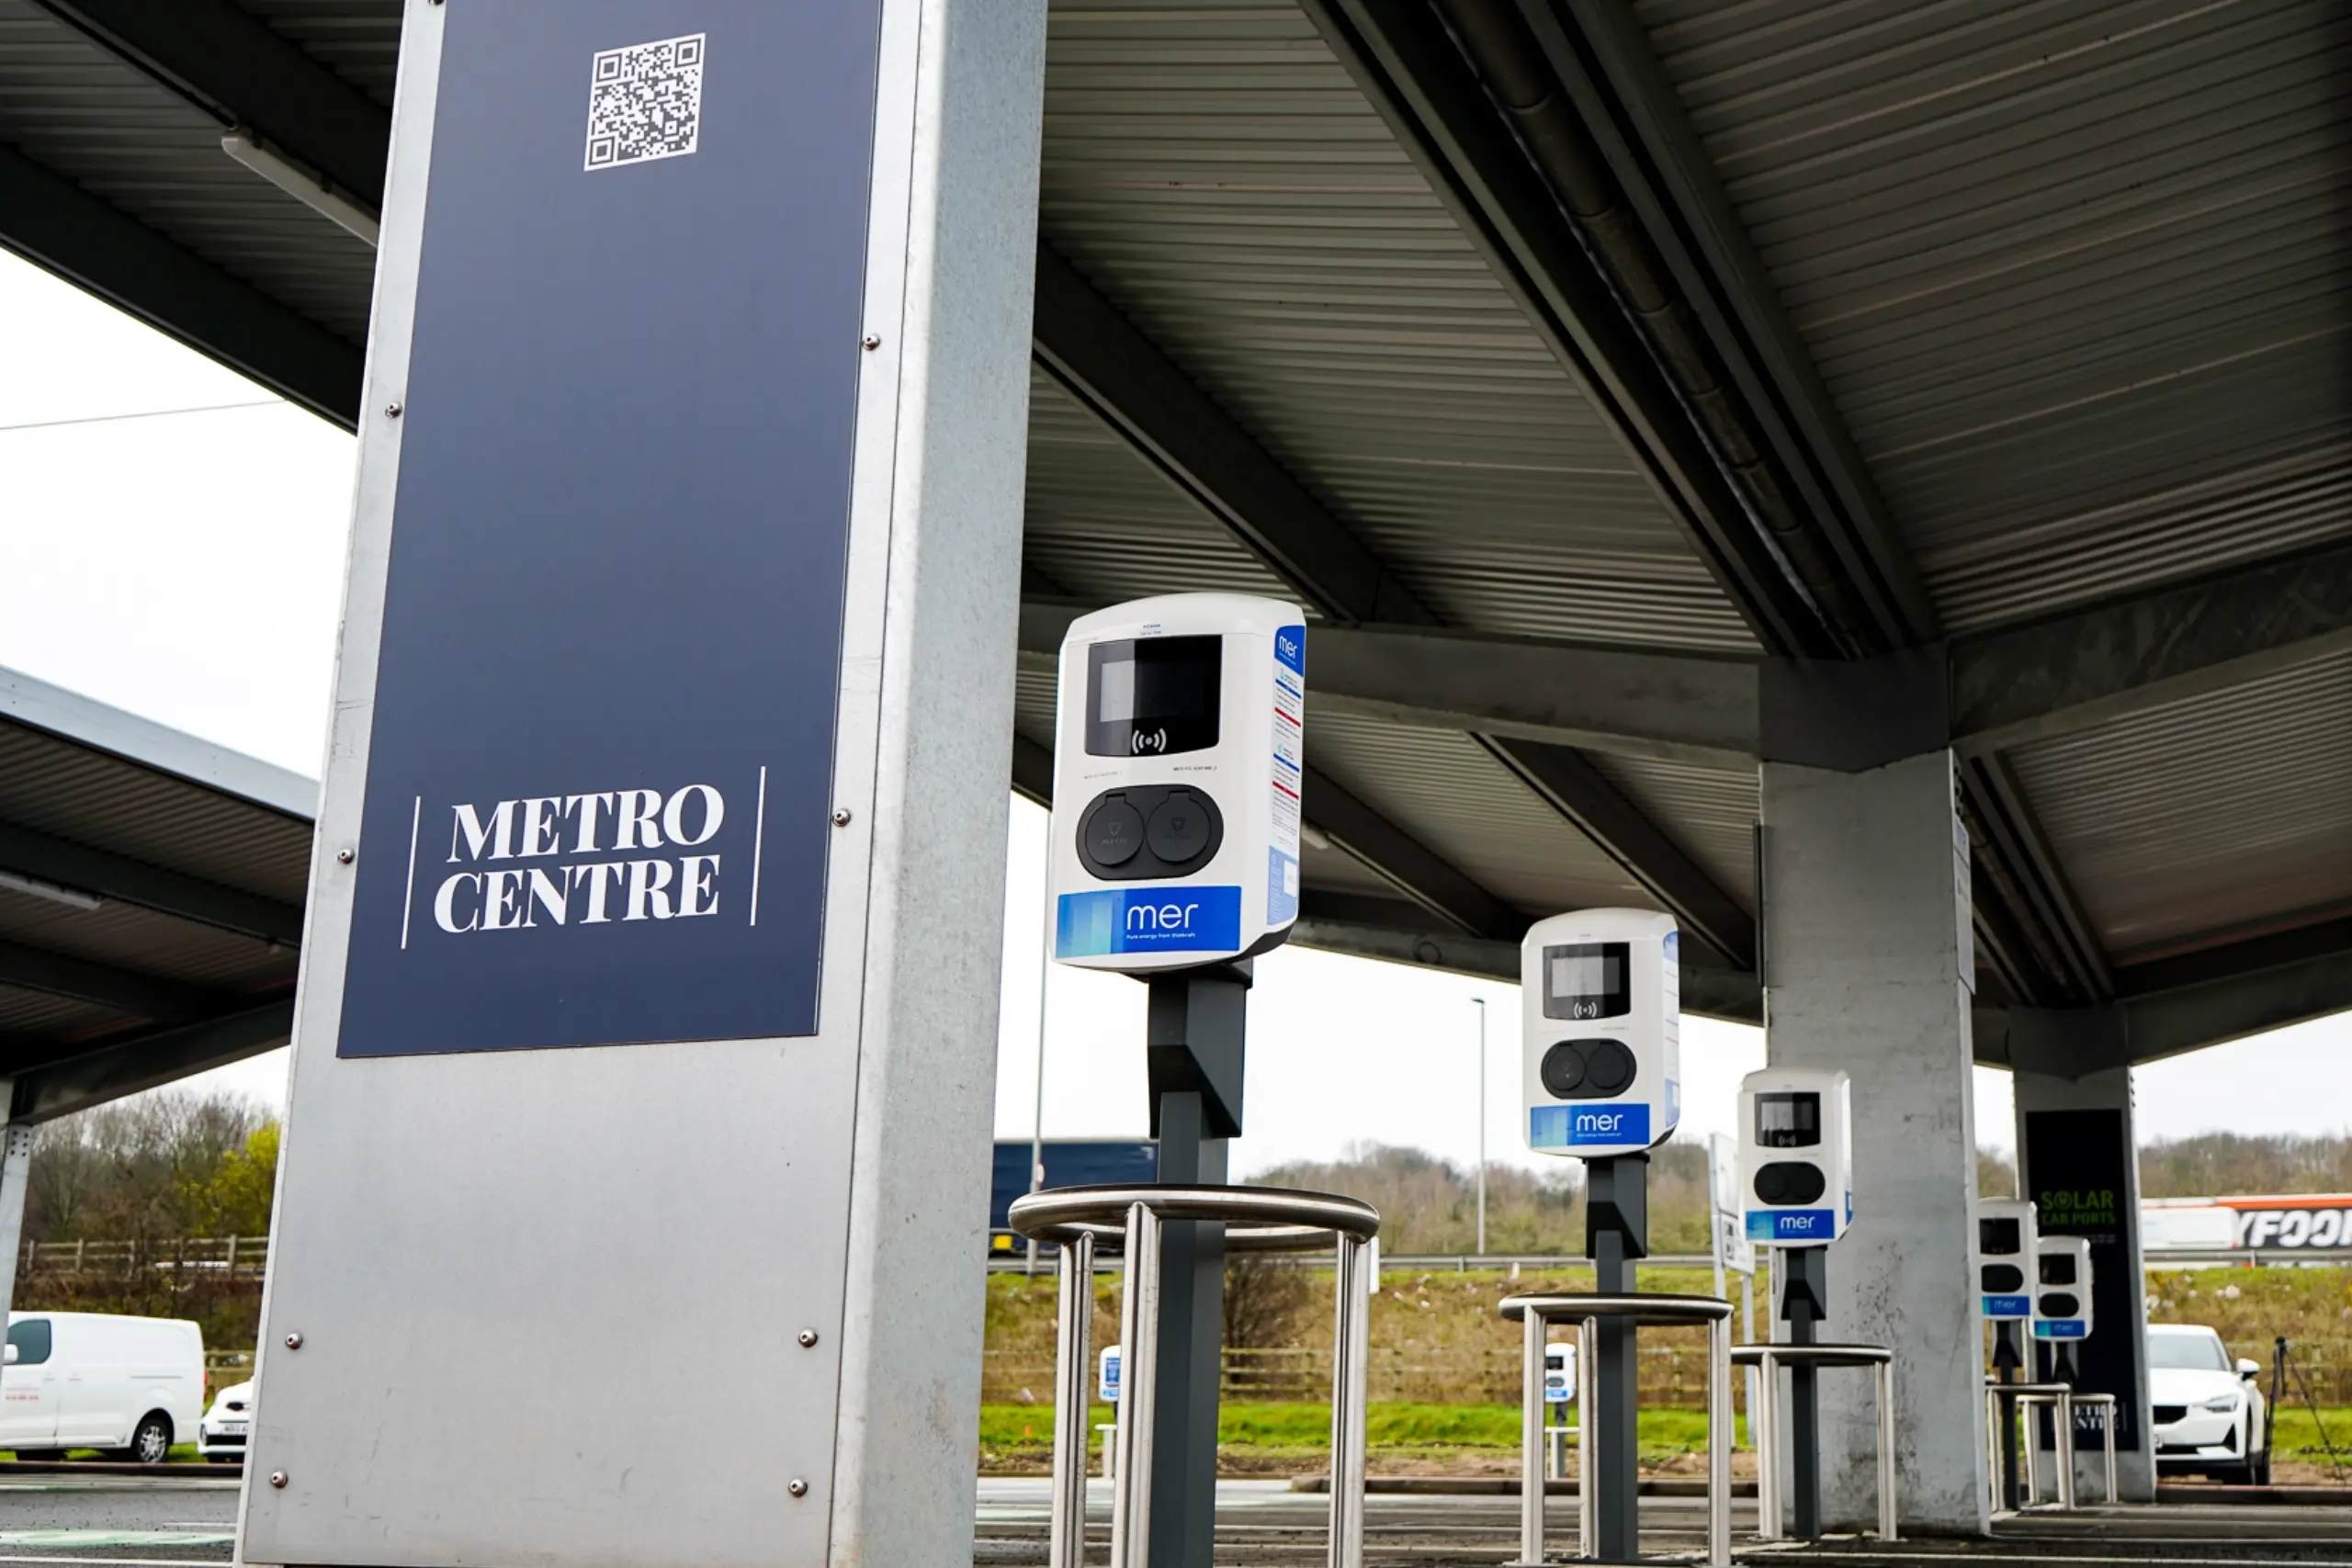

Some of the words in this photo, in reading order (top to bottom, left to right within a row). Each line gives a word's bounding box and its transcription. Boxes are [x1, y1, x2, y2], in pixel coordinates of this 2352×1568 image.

[1279, 635, 1298, 660] mer
[446, 784, 725, 863] METRO
[434, 854, 721, 933] CENTRE
[1126, 904, 1199, 931] mer
[1577, 1114, 1623, 1132] mer
[2041, 1189, 2114, 1210] SOLAR
[1780, 1215, 1815, 1229] mer
[2041, 1212, 2069, 1226] CAR
[2072, 1211, 2117, 1224] PORTS
